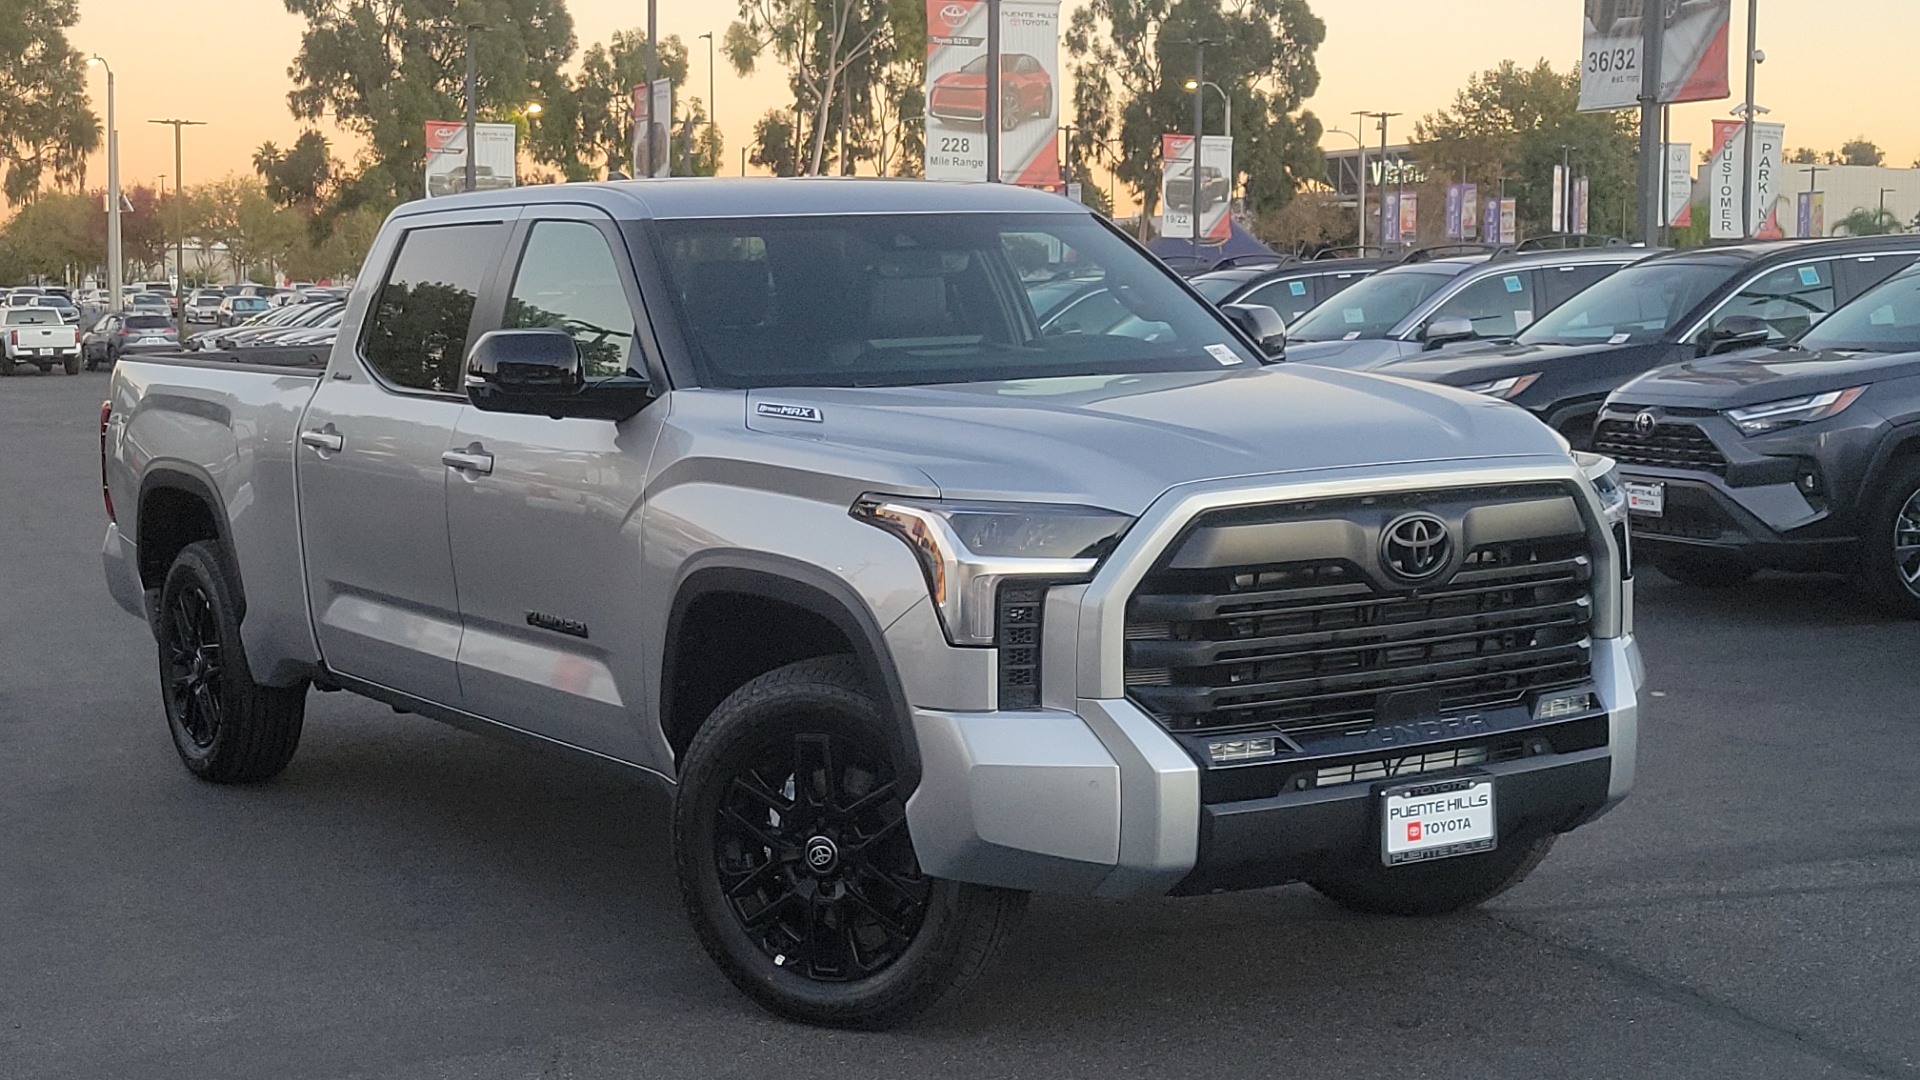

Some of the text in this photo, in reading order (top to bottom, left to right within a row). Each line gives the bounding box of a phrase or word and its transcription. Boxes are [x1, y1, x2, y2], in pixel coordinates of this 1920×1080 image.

[1588, 48, 1635, 73] 36/32
[941, 137, 970, 153] 228
[930, 156, 984, 168] Mile Range
[1720, 140, 1733, 231] CUSTOMER
[1758, 143, 1772, 231] PARKING
[1166, 214, 1188, 224] 19/22
[780, 406, 811, 416] MAX
[1414, 780, 1468, 794] TOYOTA
[1390, 795, 1488, 820] PUENTE HILLS
[1424, 817, 1471, 835] TOYOTA
